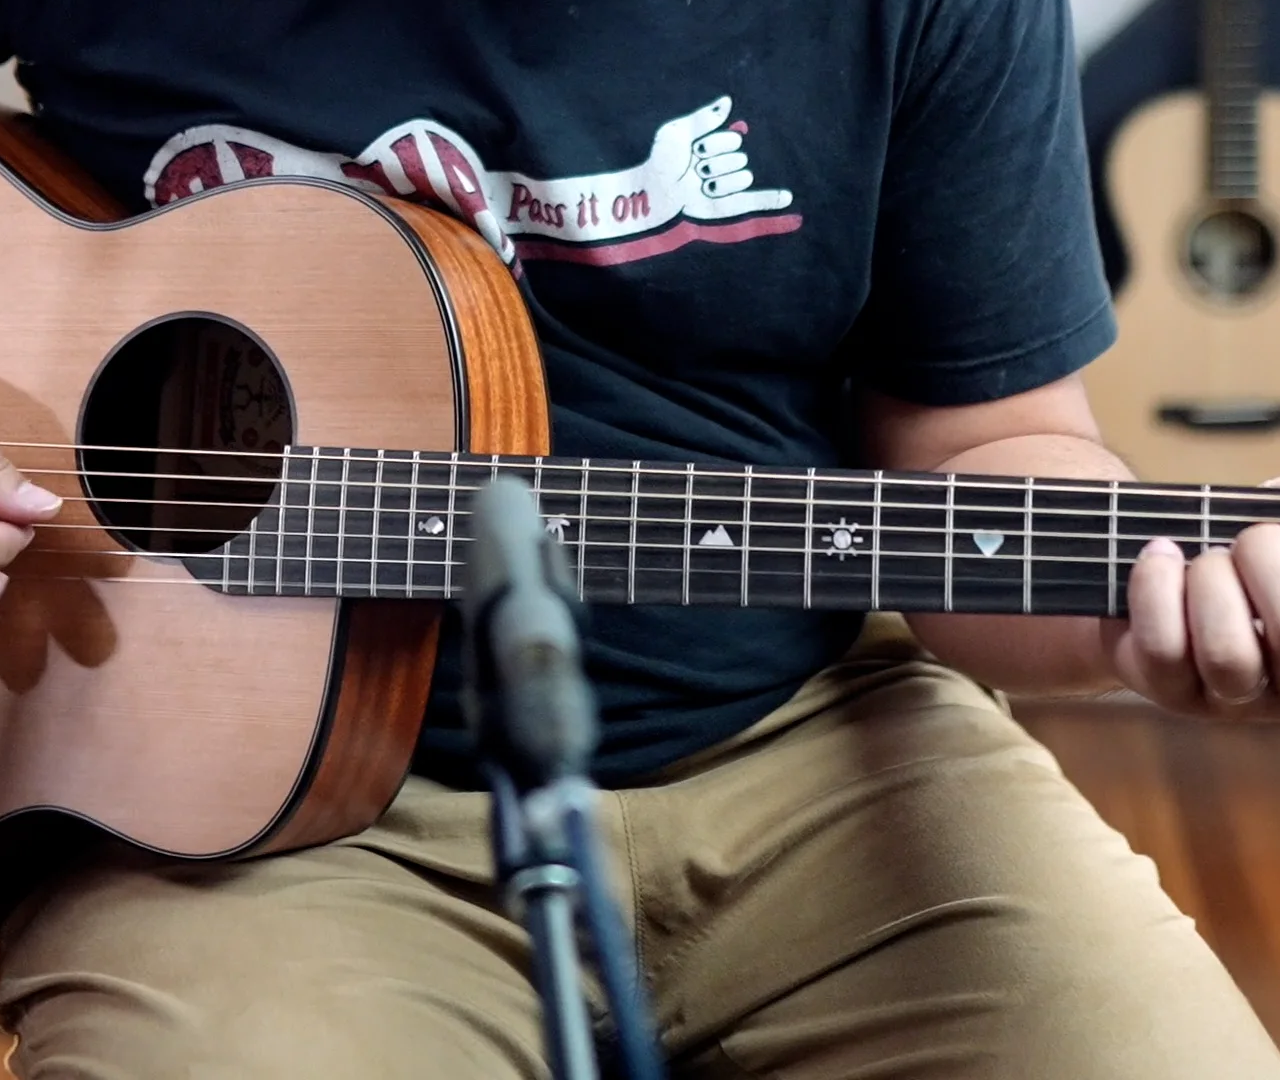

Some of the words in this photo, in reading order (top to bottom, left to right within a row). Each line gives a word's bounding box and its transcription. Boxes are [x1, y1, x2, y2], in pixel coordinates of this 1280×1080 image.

[506, 182, 567, 229] Pass
[576, 192, 601, 229] it
[611, 188, 651, 224] on
